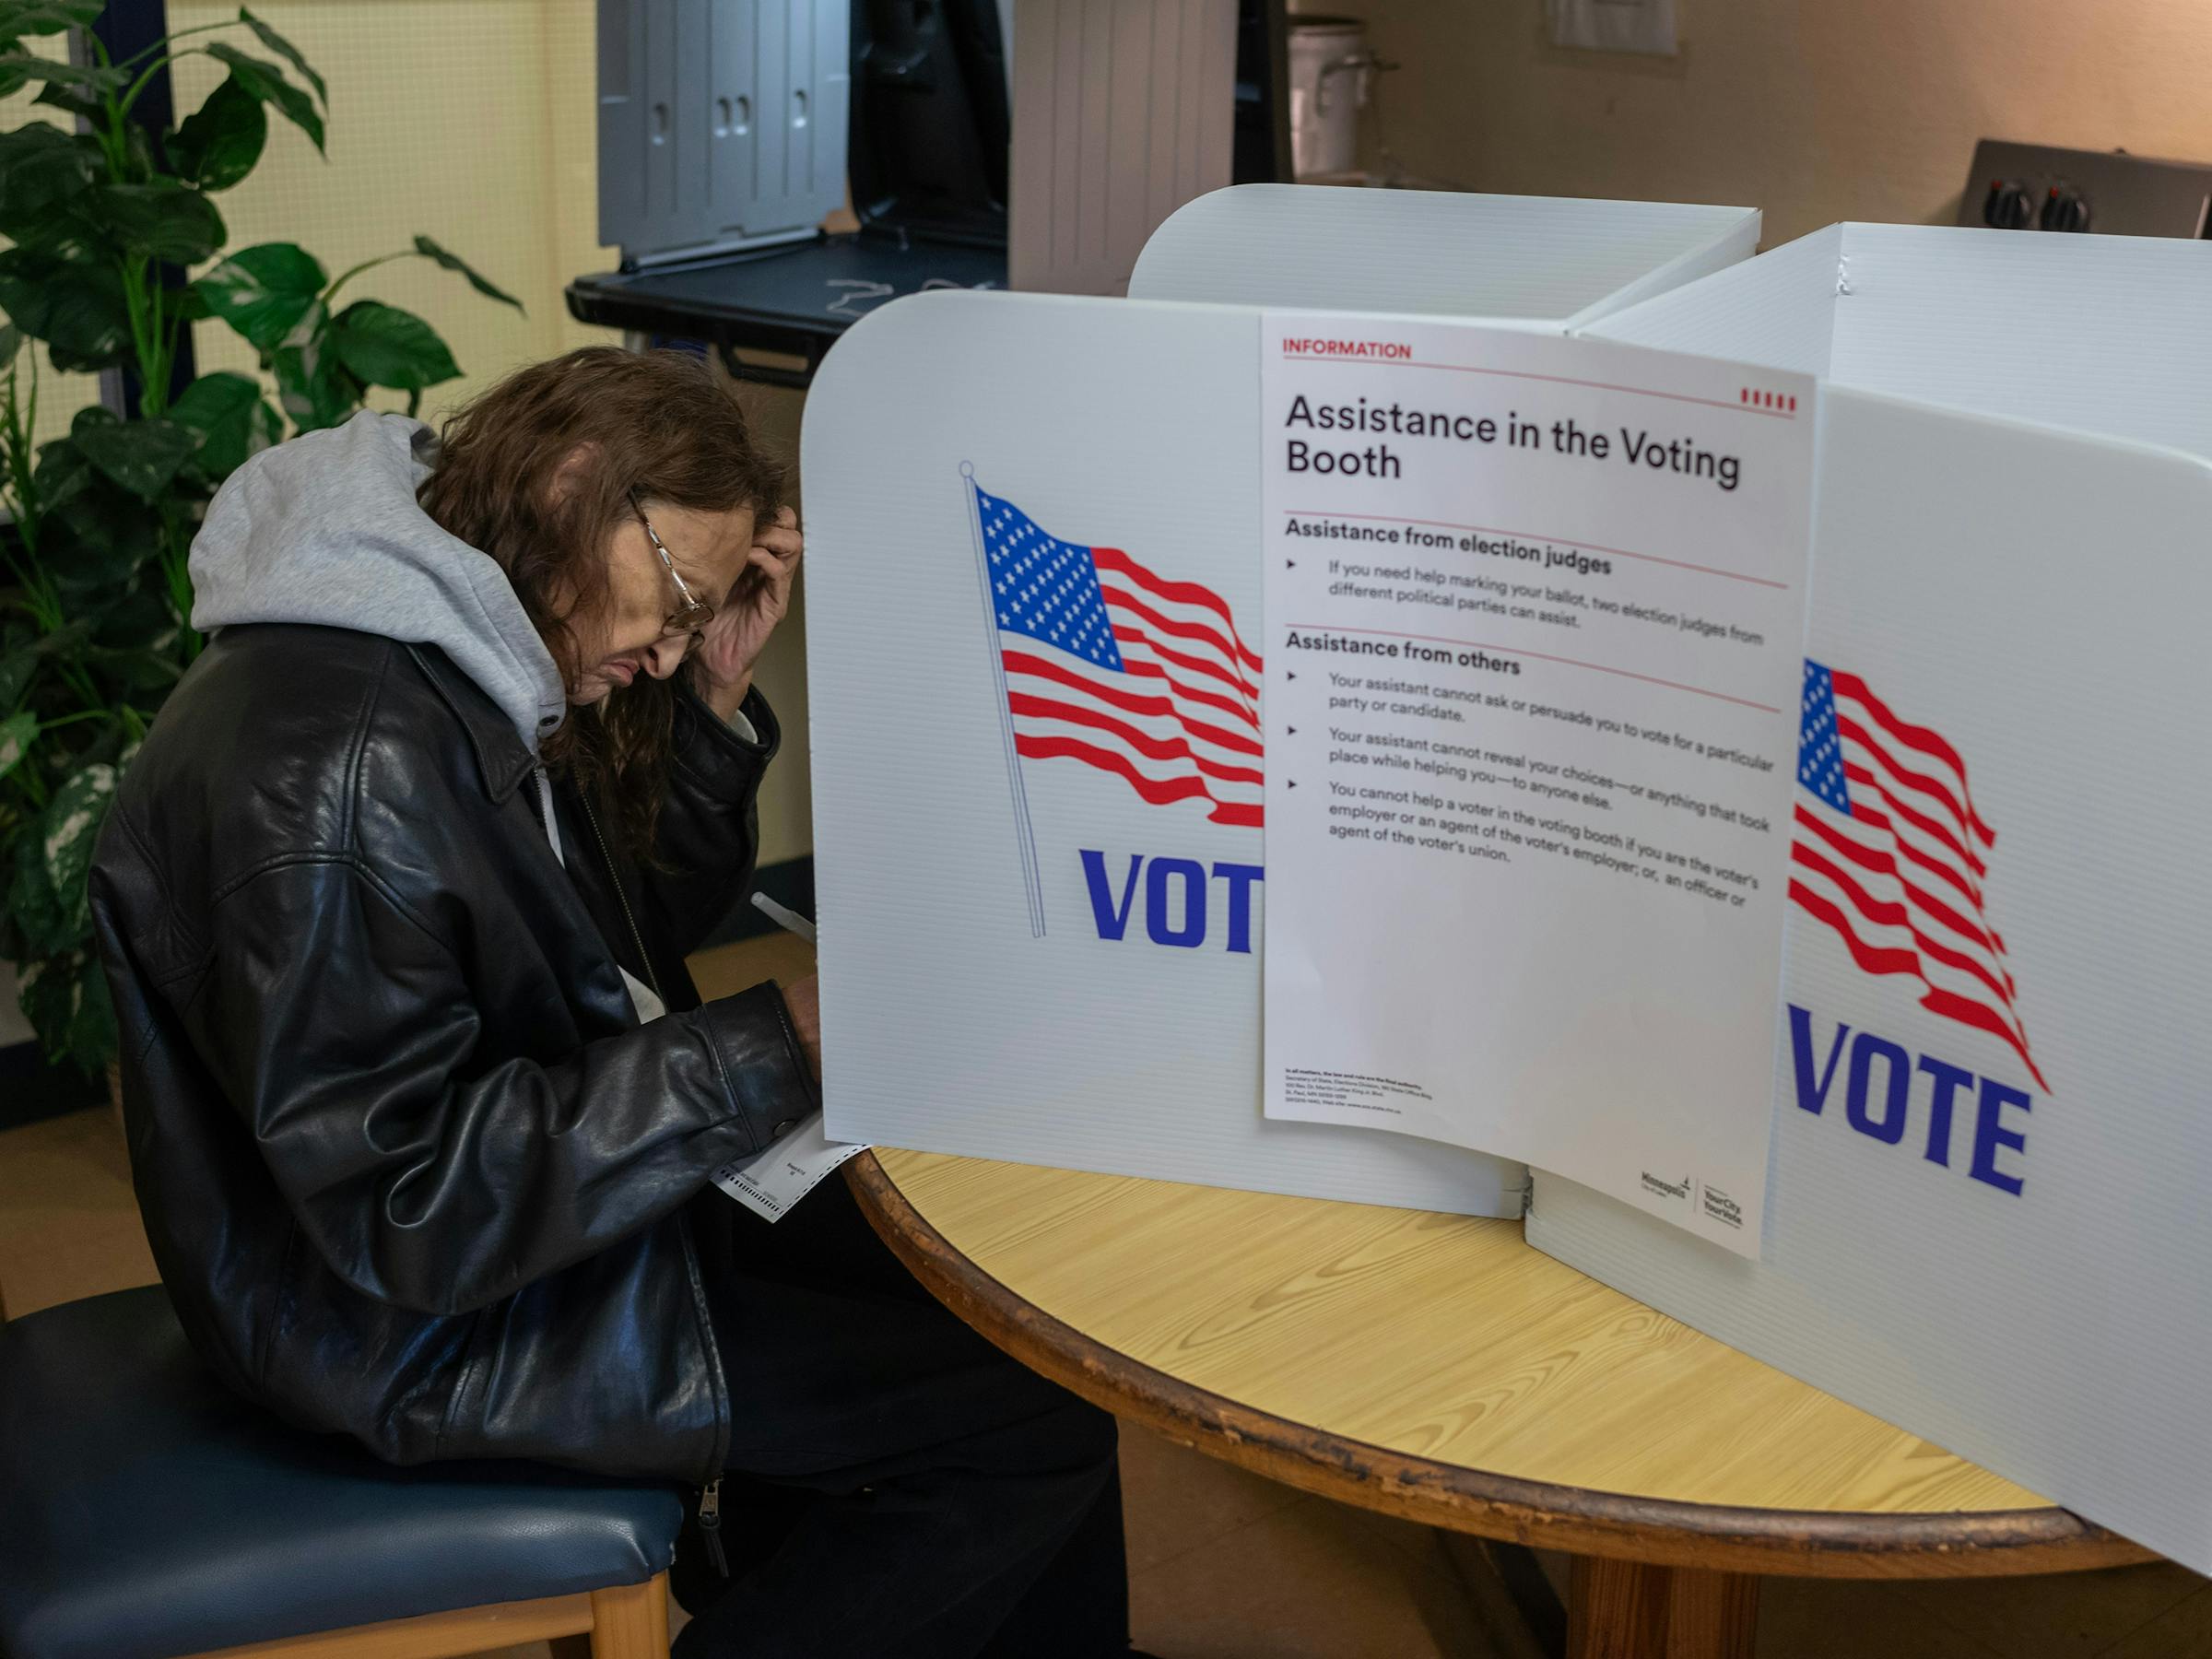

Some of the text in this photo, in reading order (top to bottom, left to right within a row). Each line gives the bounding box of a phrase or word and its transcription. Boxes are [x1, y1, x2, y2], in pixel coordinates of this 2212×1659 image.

[1283, 339, 1411, 359] INFORMATION
[1285, 394, 1740, 491] Assistance in the Voting
[1288, 440, 1401, 478] Booth
[1285, 518, 1611, 575] Assistance from election judges
[1329, 559, 1764, 645] If you need help marking your ballot, two election judges from
[1329, 582, 1581, 629] different political parties can assist.
[1286, 632, 1521, 676] Assistance from others
[1329, 696, 1465, 723] party or candidate.
[1329, 673, 1773, 772] Your assistant cannot ask or persuade you to vote for a particular
[1329, 727, 1360, 743] Your
[1366, 734, 1429, 752] assistant
[1432, 741, 1480, 759] cannot
[1485, 751, 1524, 768] reveal
[1528, 759, 1559, 775] your
[1647, 788, 1706, 817] anything
[1710, 803, 1736, 823] that
[1740, 813, 1771, 832] took
[1329, 749, 1369, 765] place
[1372, 754, 1410, 770] while
[1415, 759, 1466, 781] helping
[1530, 781, 1579, 803] anyone
[1583, 794, 1612, 810] else.
[1329, 782, 1356, 796] You
[1359, 786, 1408, 804] cannot
[1413, 791, 1443, 809] help
[1447, 801, 1454, 810] a
[1459, 802, 1494, 818] voter
[1497, 806, 1511, 819] in
[1513, 811, 1535, 826] the
[1538, 818, 1580, 840] voting
[1583, 826, 1622, 849] booth
[1626, 837, 1635, 851] if
[1638, 843, 1662, 860] you
[1665, 852, 1687, 867] are
[1689, 857, 1711, 875] the
[1329, 824, 1370, 839] agent
[1373, 828, 1389, 841] of
[1392, 830, 1415, 844] the
[1469, 845, 1511, 863] union.
[1329, 805, 1396, 822] employer
[1400, 813, 1415, 824] or
[1418, 816, 1436, 828] an
[1439, 819, 1478, 834] agent
[1482, 827, 1497, 838] of
[1500, 828, 1522, 843] the
[1573, 847, 1640, 877] employer;
[1641, 865, 1659, 882] or,
[1665, 875, 1682, 887] an
[1685, 878, 1727, 901] officer
[1730, 894, 1746, 908] or
[1079, 849, 1265, 953] VOT
[1787, 1003, 2031, 1197] VOTE
